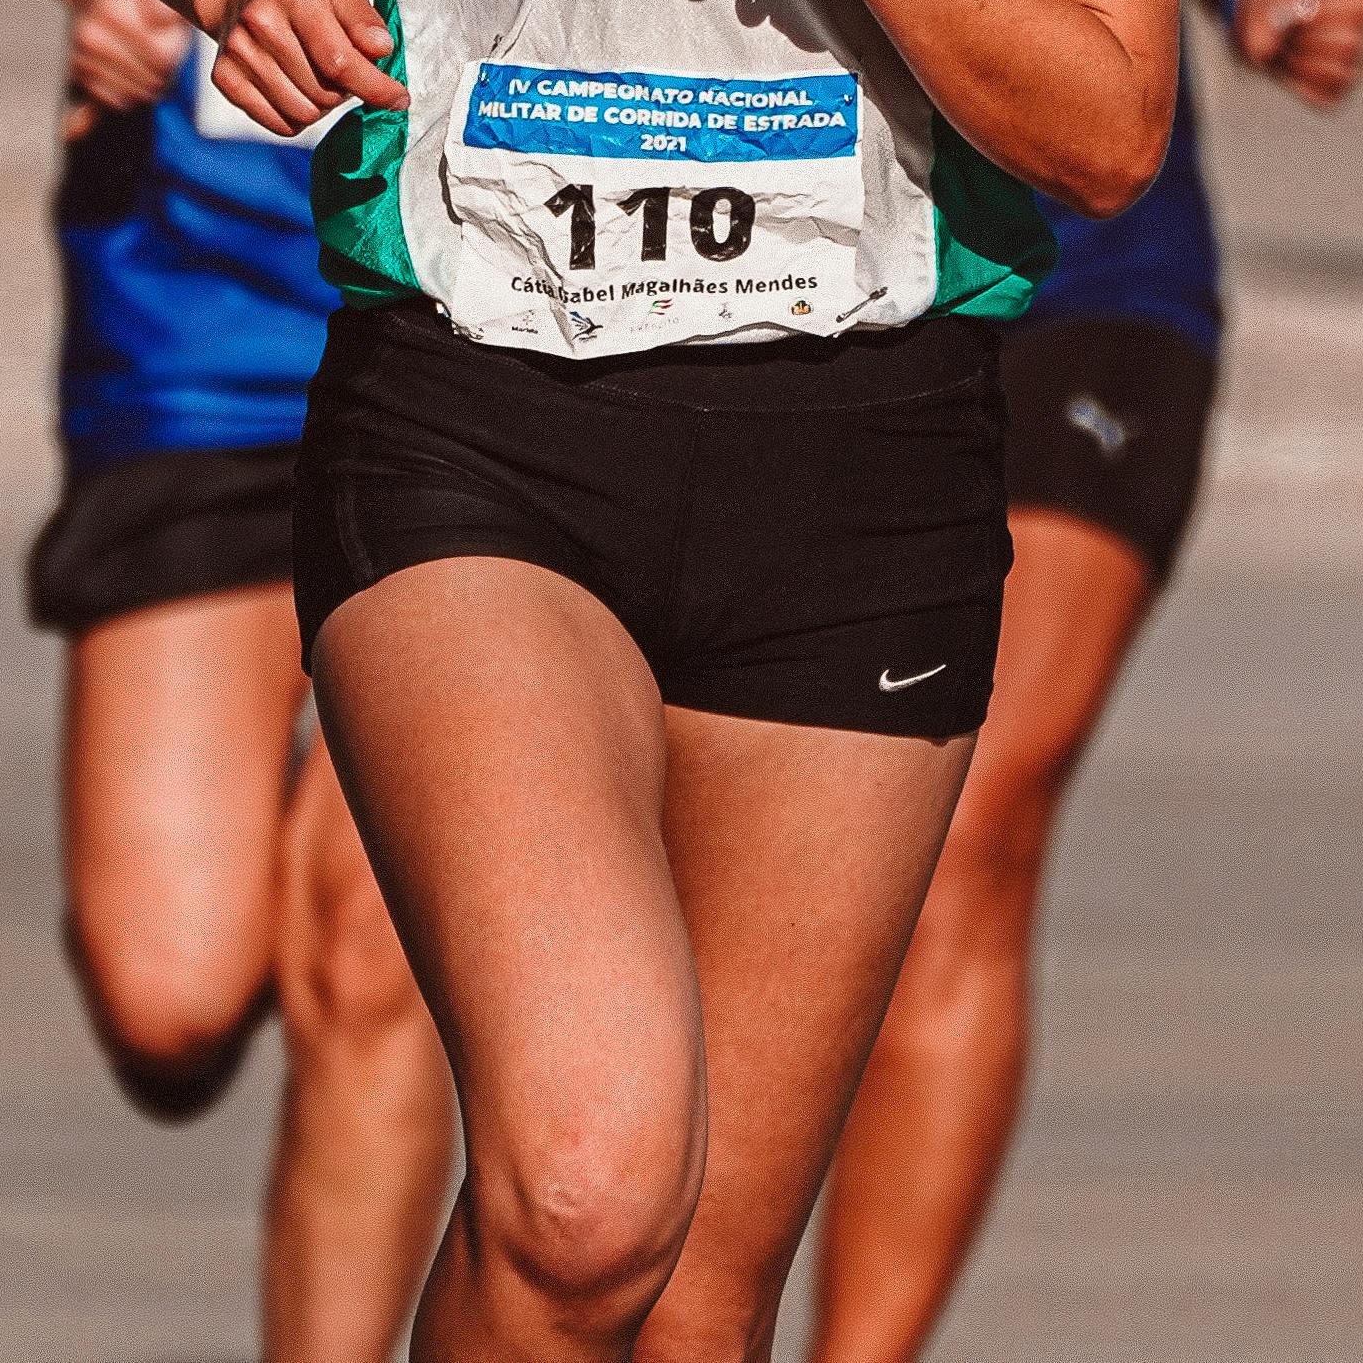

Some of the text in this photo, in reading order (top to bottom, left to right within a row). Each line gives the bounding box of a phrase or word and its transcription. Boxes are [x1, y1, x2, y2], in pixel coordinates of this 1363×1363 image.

[508, 79, 812, 108] IV CAMPEONATO NACIONAL
[478, 101, 846, 131] MILITAR DE CORRIDA DE ESTRADA
[640, 134, 686, 152] 2021
[544, 183, 756, 271] 110
[621, 277, 729, 300] Magalhães
[736, 274, 818, 294] Mendes
